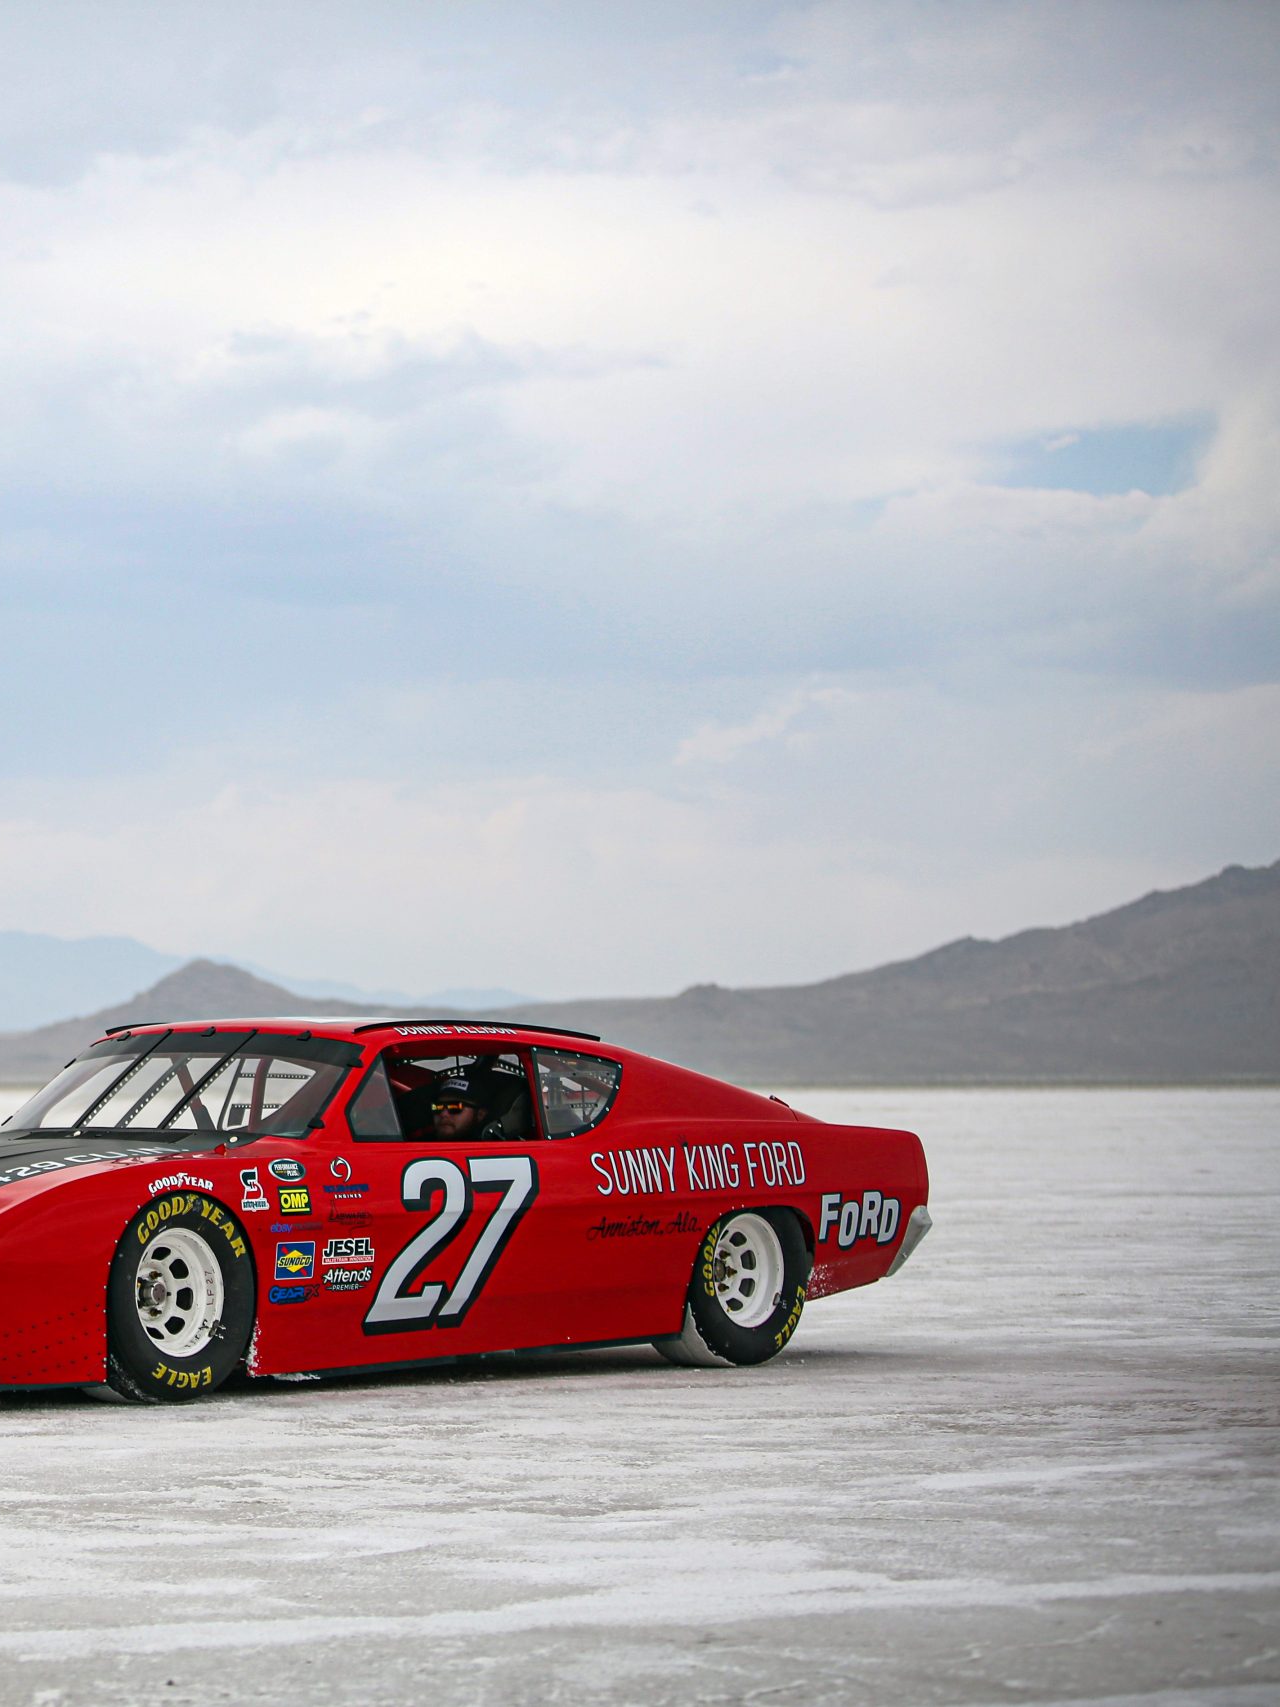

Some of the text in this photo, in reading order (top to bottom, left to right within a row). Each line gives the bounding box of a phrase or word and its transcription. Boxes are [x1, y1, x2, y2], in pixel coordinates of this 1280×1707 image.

[393, 1026, 517, 1036] DONNIE ALLISON
[590, 1141, 806, 1196] SUNNY KING FORD
[280, 1193, 309, 1209] OMP
[323, 1239, 374, 1257] JESEL
[361, 1156, 540, 1336] 27
[278, 1256, 312, 1267] SUNOCO
[323, 1267, 372, 1284] Attends
[775, 1285, 806, 1348] EAGLE
[151, 1362, 213, 1389] EAGLE
